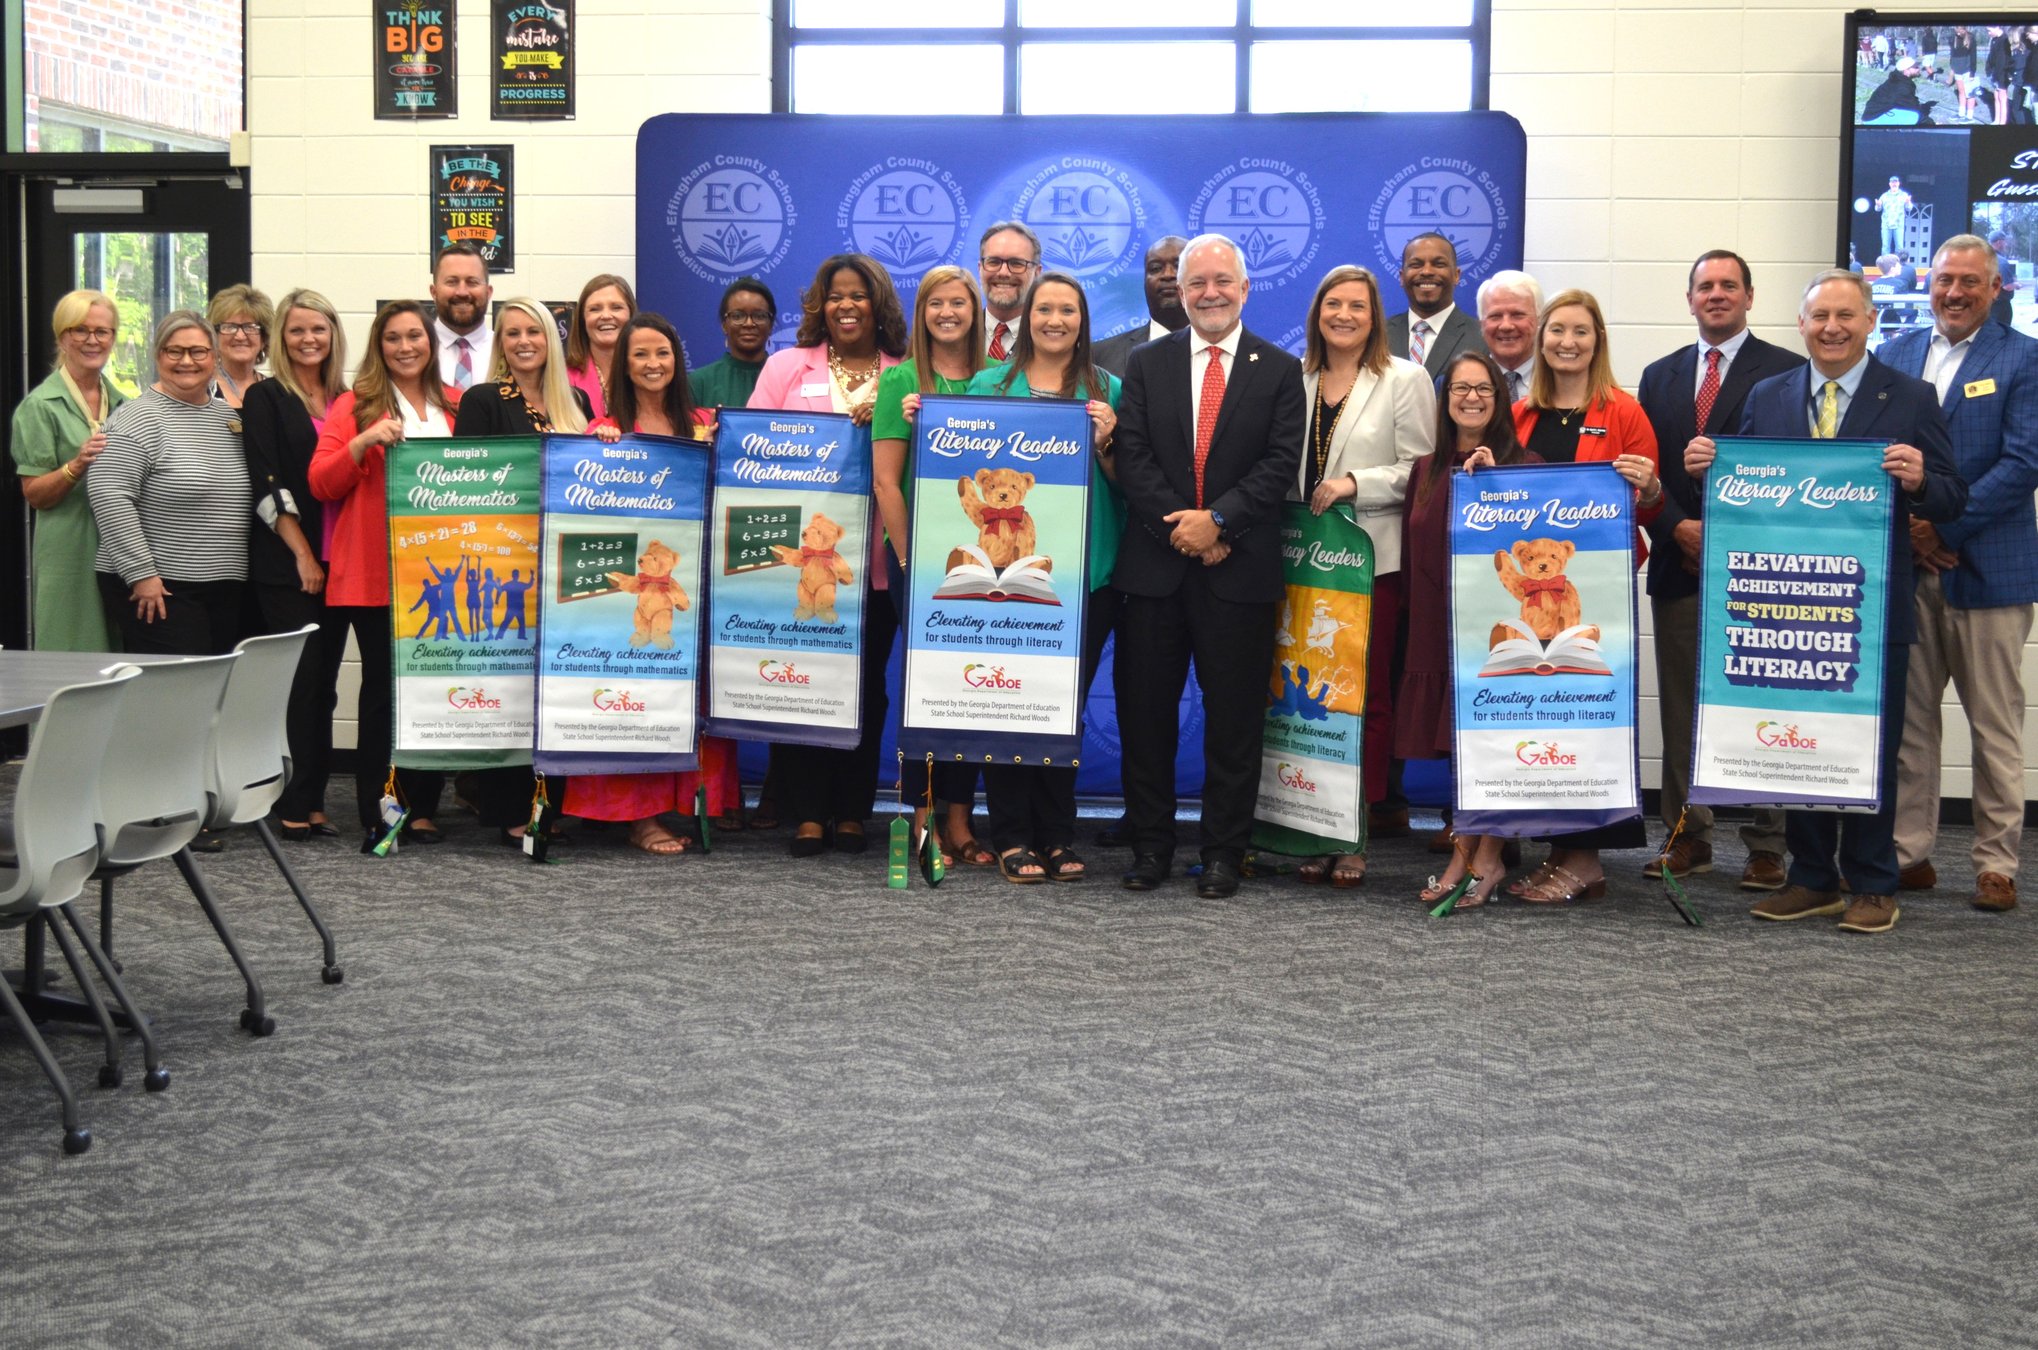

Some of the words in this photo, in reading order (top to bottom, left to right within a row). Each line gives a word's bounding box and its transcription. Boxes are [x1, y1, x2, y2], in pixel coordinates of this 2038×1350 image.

[386, 10, 443, 25] THINK
[508, 6, 556, 22] EVERY
[386, 26, 442, 52] BIG
[506, 28, 559, 48] mistake
[515, 54, 528, 62] YOU
[530, 54, 549, 62] MAKE
[403, 93, 428, 104] KNOW
[500, 89, 565, 98] PROGRESS
[449, 161, 464, 171] BE
[469, 160, 492, 170] THE
[450, 176, 505, 192] Change
[667, 162, 711, 225] Effingham
[715, 155, 766, 174] County
[768, 169, 798, 226] Schools
[837, 164, 884, 228] Effingham
[887, 157, 940, 176] County
[941, 171, 971, 227] Schools
[1012, 164, 1058, 221] ffingham
[1062, 157, 1116, 176] County
[1117, 172, 1147, 229] Schools
[1188, 164, 1236, 231] Effingham
[1239, 157, 1295, 176] County
[1296, 172, 1326, 230] Schools
[1368, 164, 1417, 231] Effingham
[1421, 157, 1477, 176] County
[1477, 171, 1509, 229] Schools
[1987, 179, 2038, 197] Gues
[449, 198, 467, 207] YOU
[471, 198, 495, 207] WISH
[702, 182, 762, 214] EC
[874, 184, 934, 216] EC
[1049, 185, 1110, 217] EC
[1227, 185, 1289, 218] EC
[1407, 185, 1471, 218] EC
[450, 212, 465, 227] TO
[470, 212, 492, 227] SEE
[672, 235, 715, 282] Tradition
[761, 239, 792, 274] Vision
[1109, 243, 1140, 278] Vision
[1287, 243, 1320, 279] Vision
[1469, 243, 1502, 279] Vision
[770, 422, 815, 434] Georgia's
[947, 417, 995, 431] Georgia's
[444, 448, 488, 459] Georgia's
[603, 448, 647, 460] Georgia's
[742, 433, 813, 459] Masters
[816, 440, 839, 463] of
[927, 427, 1004, 459] Literacy
[1008, 431, 1080, 461] Leaders
[417, 461, 489, 486] Masters
[492, 463, 513, 486] of
[574, 459, 647, 485] Masters
[651, 467, 672, 489] of
[733, 458, 841, 483] Mathematics
[1736, 464, 1786, 478] Georgia's
[408, 486, 519, 511] Mathematics
[564, 484, 676, 510] Mathematics
[1481, 490, 1529, 503] Georgia's
[1716, 475, 1795, 507] Literacy
[1798, 477, 1879, 509] Leaders
[1462, 502, 1540, 531] Literacy
[1543, 499, 1621, 528] Leaders
[1309, 541, 1365, 571] Leaders
[1727, 552, 1858, 575] ELEVATING
[1726, 578, 1856, 597] ACHIEVEMENT
[926, 611, 987, 632] Elevating
[990, 617, 1064, 631] achievement
[1726, 601, 1747, 610] FOR
[1747, 603, 1854, 622] STUDENTS
[725, 614, 778, 635] Elevating
[781, 621, 847, 635] achievement
[720, 632, 730, 641] for
[733, 633, 765, 644] students
[768, 636, 798, 647] through
[801, 639, 853, 649] mathematics
[926, 632, 938, 642] for
[942, 633, 982, 644] students
[986, 635, 1022, 648] through
[1026, 637, 1062, 649] literacy
[1725, 627, 1853, 652] THROUGH
[412, 643, 466, 662] Elevating
[557, 643, 613, 663] Elevating
[616, 649, 683, 661] achievement
[407, 663, 418, 671] for
[420, 663, 453, 671] students
[456, 663, 487, 672] through
[551, 662, 562, 671] for
[565, 663, 600, 672] students
[603, 663, 633, 675] through
[636, 665, 688, 675] mathematics
[1724, 655, 1850, 681] LITERACY
[922, 698, 949, 706] Presented
[951, 699, 957, 707] by
[970, 700, 990, 709] Georgia
[992, 702, 1024, 710] Department
[1473, 688, 1536, 709] Elevating
[1540, 690, 1617, 703] achievement
[966, 711, 1008, 720] Superintendent
[1032, 714, 1049, 722] Woods
[1474, 711, 1487, 721] for
[1491, 711, 1533, 721] students
[1536, 710, 1575, 722] through
[1578, 710, 1615, 721] literacy
[1293, 723, 1347, 742] achievement
[1291, 739, 1315, 754] through
[1318, 745, 1346, 760] literacy
[1713, 756, 1741, 764] Presented
[1743, 759, 1749, 767] by
[1762, 760, 1784, 770] Georgia
[1785, 761, 1821, 771] Department
[1823, 764, 1829, 772] of
[1830, 764, 1859, 774] Education
[1524, 780, 1545, 788] Georgia
[1547, 779, 1581, 788] Department
[1591, 778, 1618, 786] Education
[1722, 768, 1737, 776] State
[1738, 770, 1757, 778] School
[1759, 771, 1803, 781] Superintendent
[1805, 774, 1827, 783] Richard
[1829, 776, 1848, 785] Woods
[1522, 790, 1566, 799] Superintendent
